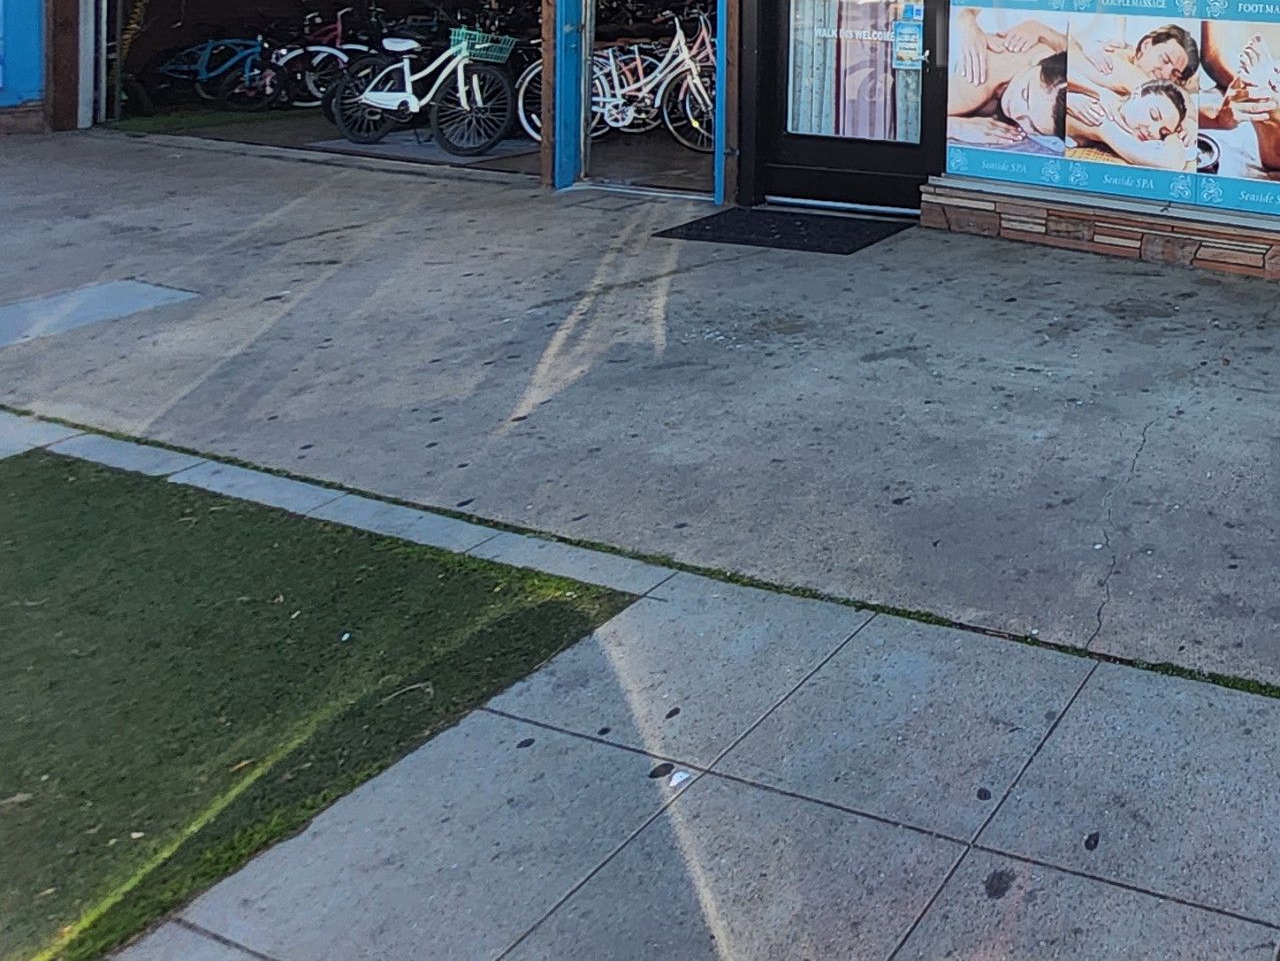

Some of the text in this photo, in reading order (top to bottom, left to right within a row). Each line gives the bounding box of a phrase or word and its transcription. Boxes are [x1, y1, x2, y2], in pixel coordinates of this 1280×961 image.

[1238, 2, 1264, 13] FOOT
[814, 28, 837, 39] WALK
[855, 30, 895, 42] WELCOME
[981, 158, 1027, 174] Seaside SPA
[1102, 174, 1155, 190] Seaside SPA
[1239, 190, 1274, 204] Seaside
